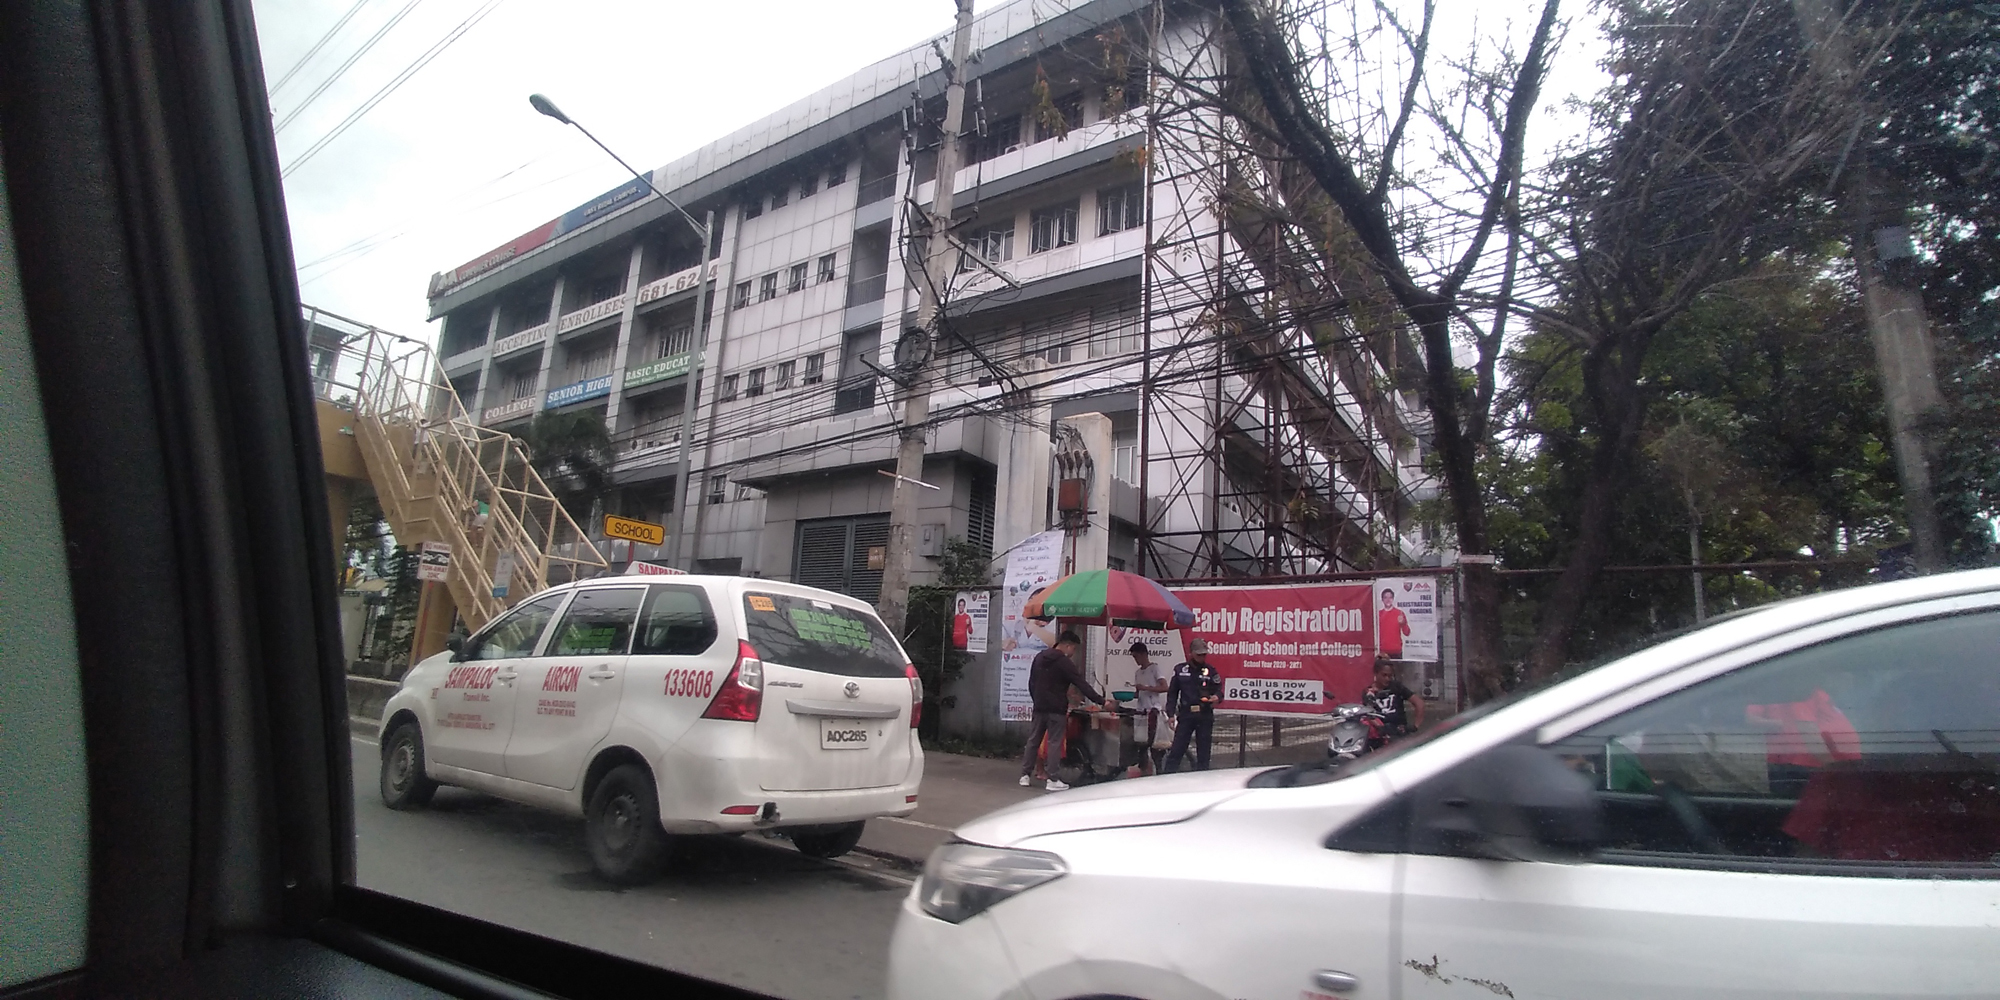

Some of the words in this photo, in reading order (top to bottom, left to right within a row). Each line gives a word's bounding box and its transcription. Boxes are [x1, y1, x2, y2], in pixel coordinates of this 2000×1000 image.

[641, 264, 718, 303] 681-624
[561, 297, 625, 330] ENROLLEES
[625, 366, 652, 381] BASIC
[653, 351, 707, 374] EDUCATN
[547, 384, 584, 403] SENIOR
[585, 376, 613, 393] HIGH
[485, 397, 536, 419] COLLEGE
[614, 522, 655, 540] SCHOOL
[638, 563, 687, 575] SAMPAL
[1191, 607, 1238, 635] Early
[1240, 605, 1362, 635] Registration
[1127, 636, 1168, 645] COLLEGE
[1207, 641, 1238, 654] Senior
[1239, 641, 1261, 656] High
[1263, 641, 1298, 655] School
[1299, 641, 1319, 655] and
[1321, 641, 1362, 658] College
[1148, 649, 1172, 657] AMPUS
[1243, 660, 1261, 668] School
[1261, 660, 1273, 668] Year
[1273, 661, 1286, 669] 2020
[445, 666, 500, 689] SAMPALOC
[542, 666, 583, 692] AIRCON
[664, 668, 714, 698] 133608
[1240, 679, 1262, 687] Call
[1229, 688, 1317, 702] 86816244
[1007, 704, 1027, 712] Enroll
